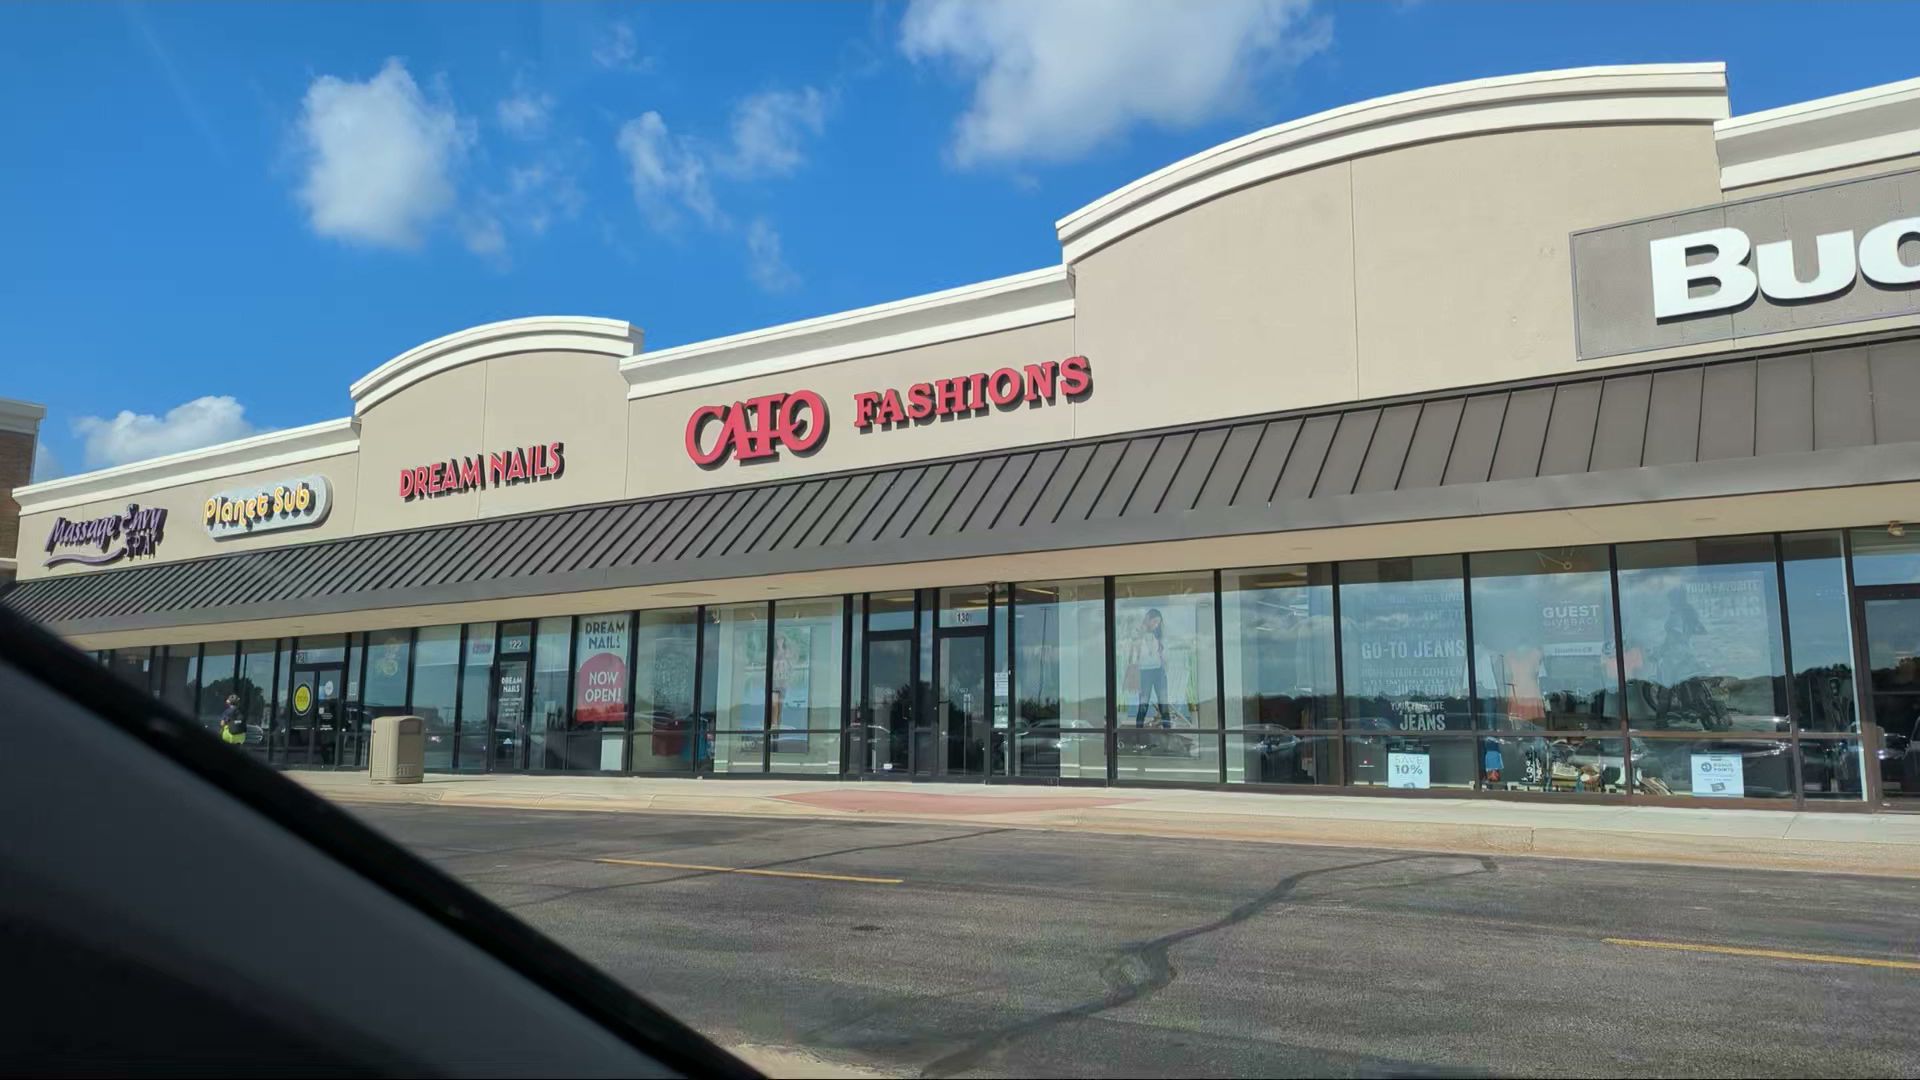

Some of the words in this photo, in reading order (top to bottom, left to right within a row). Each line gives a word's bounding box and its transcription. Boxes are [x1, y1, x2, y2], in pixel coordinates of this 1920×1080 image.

[685, 389, 830, 467] CATO
[854, 355, 1092, 430] FASHIONS
[399, 455, 486, 502] DREAM
[489, 442, 564, 488] NAILS
[203, 493, 275, 528] Planet
[273, 482, 316, 517] Sub
[44, 515, 121, 555] Massage
[120, 504, 167, 545] Envy
[1542, 604, 1601, 618] GUEST
[585, 621, 625, 635] DREAM
[1361, 640, 1408, 660] GO-TO
[1413, 639, 1466, 658] JEANS
[588, 671, 619, 686] NOW
[584, 687, 623, 704] OPEN!
[1399, 714, 1446, 731] JEANS
[1395, 764, 1424, 775] 10%
